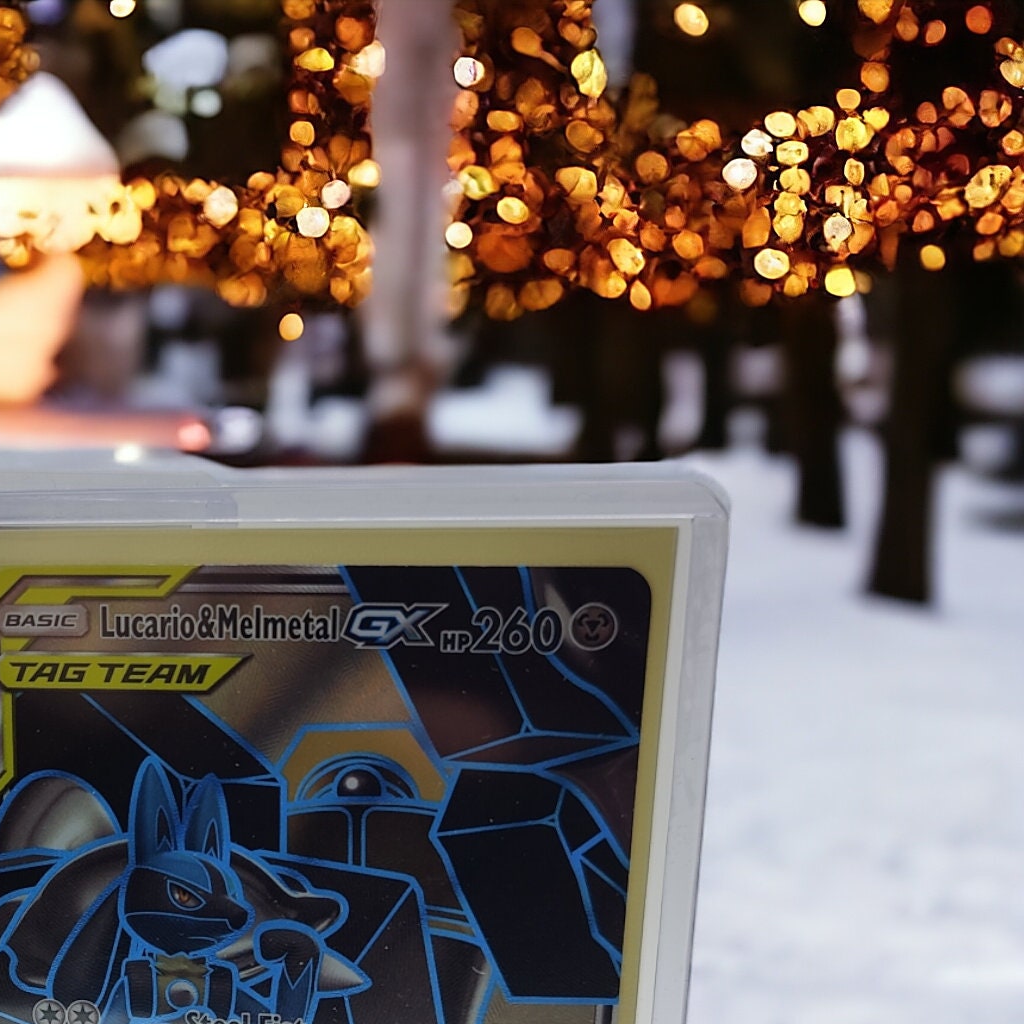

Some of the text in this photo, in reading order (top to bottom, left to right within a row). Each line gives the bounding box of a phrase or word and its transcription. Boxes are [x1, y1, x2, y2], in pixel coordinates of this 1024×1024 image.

[5, 614, 77, 627] BASIC
[99, 604, 340, 643] Lucario&Melmetal
[341, 603, 448, 648] GX
[471, 606, 564, 654] 260
[10, 662, 212, 685] TAG TEAM
